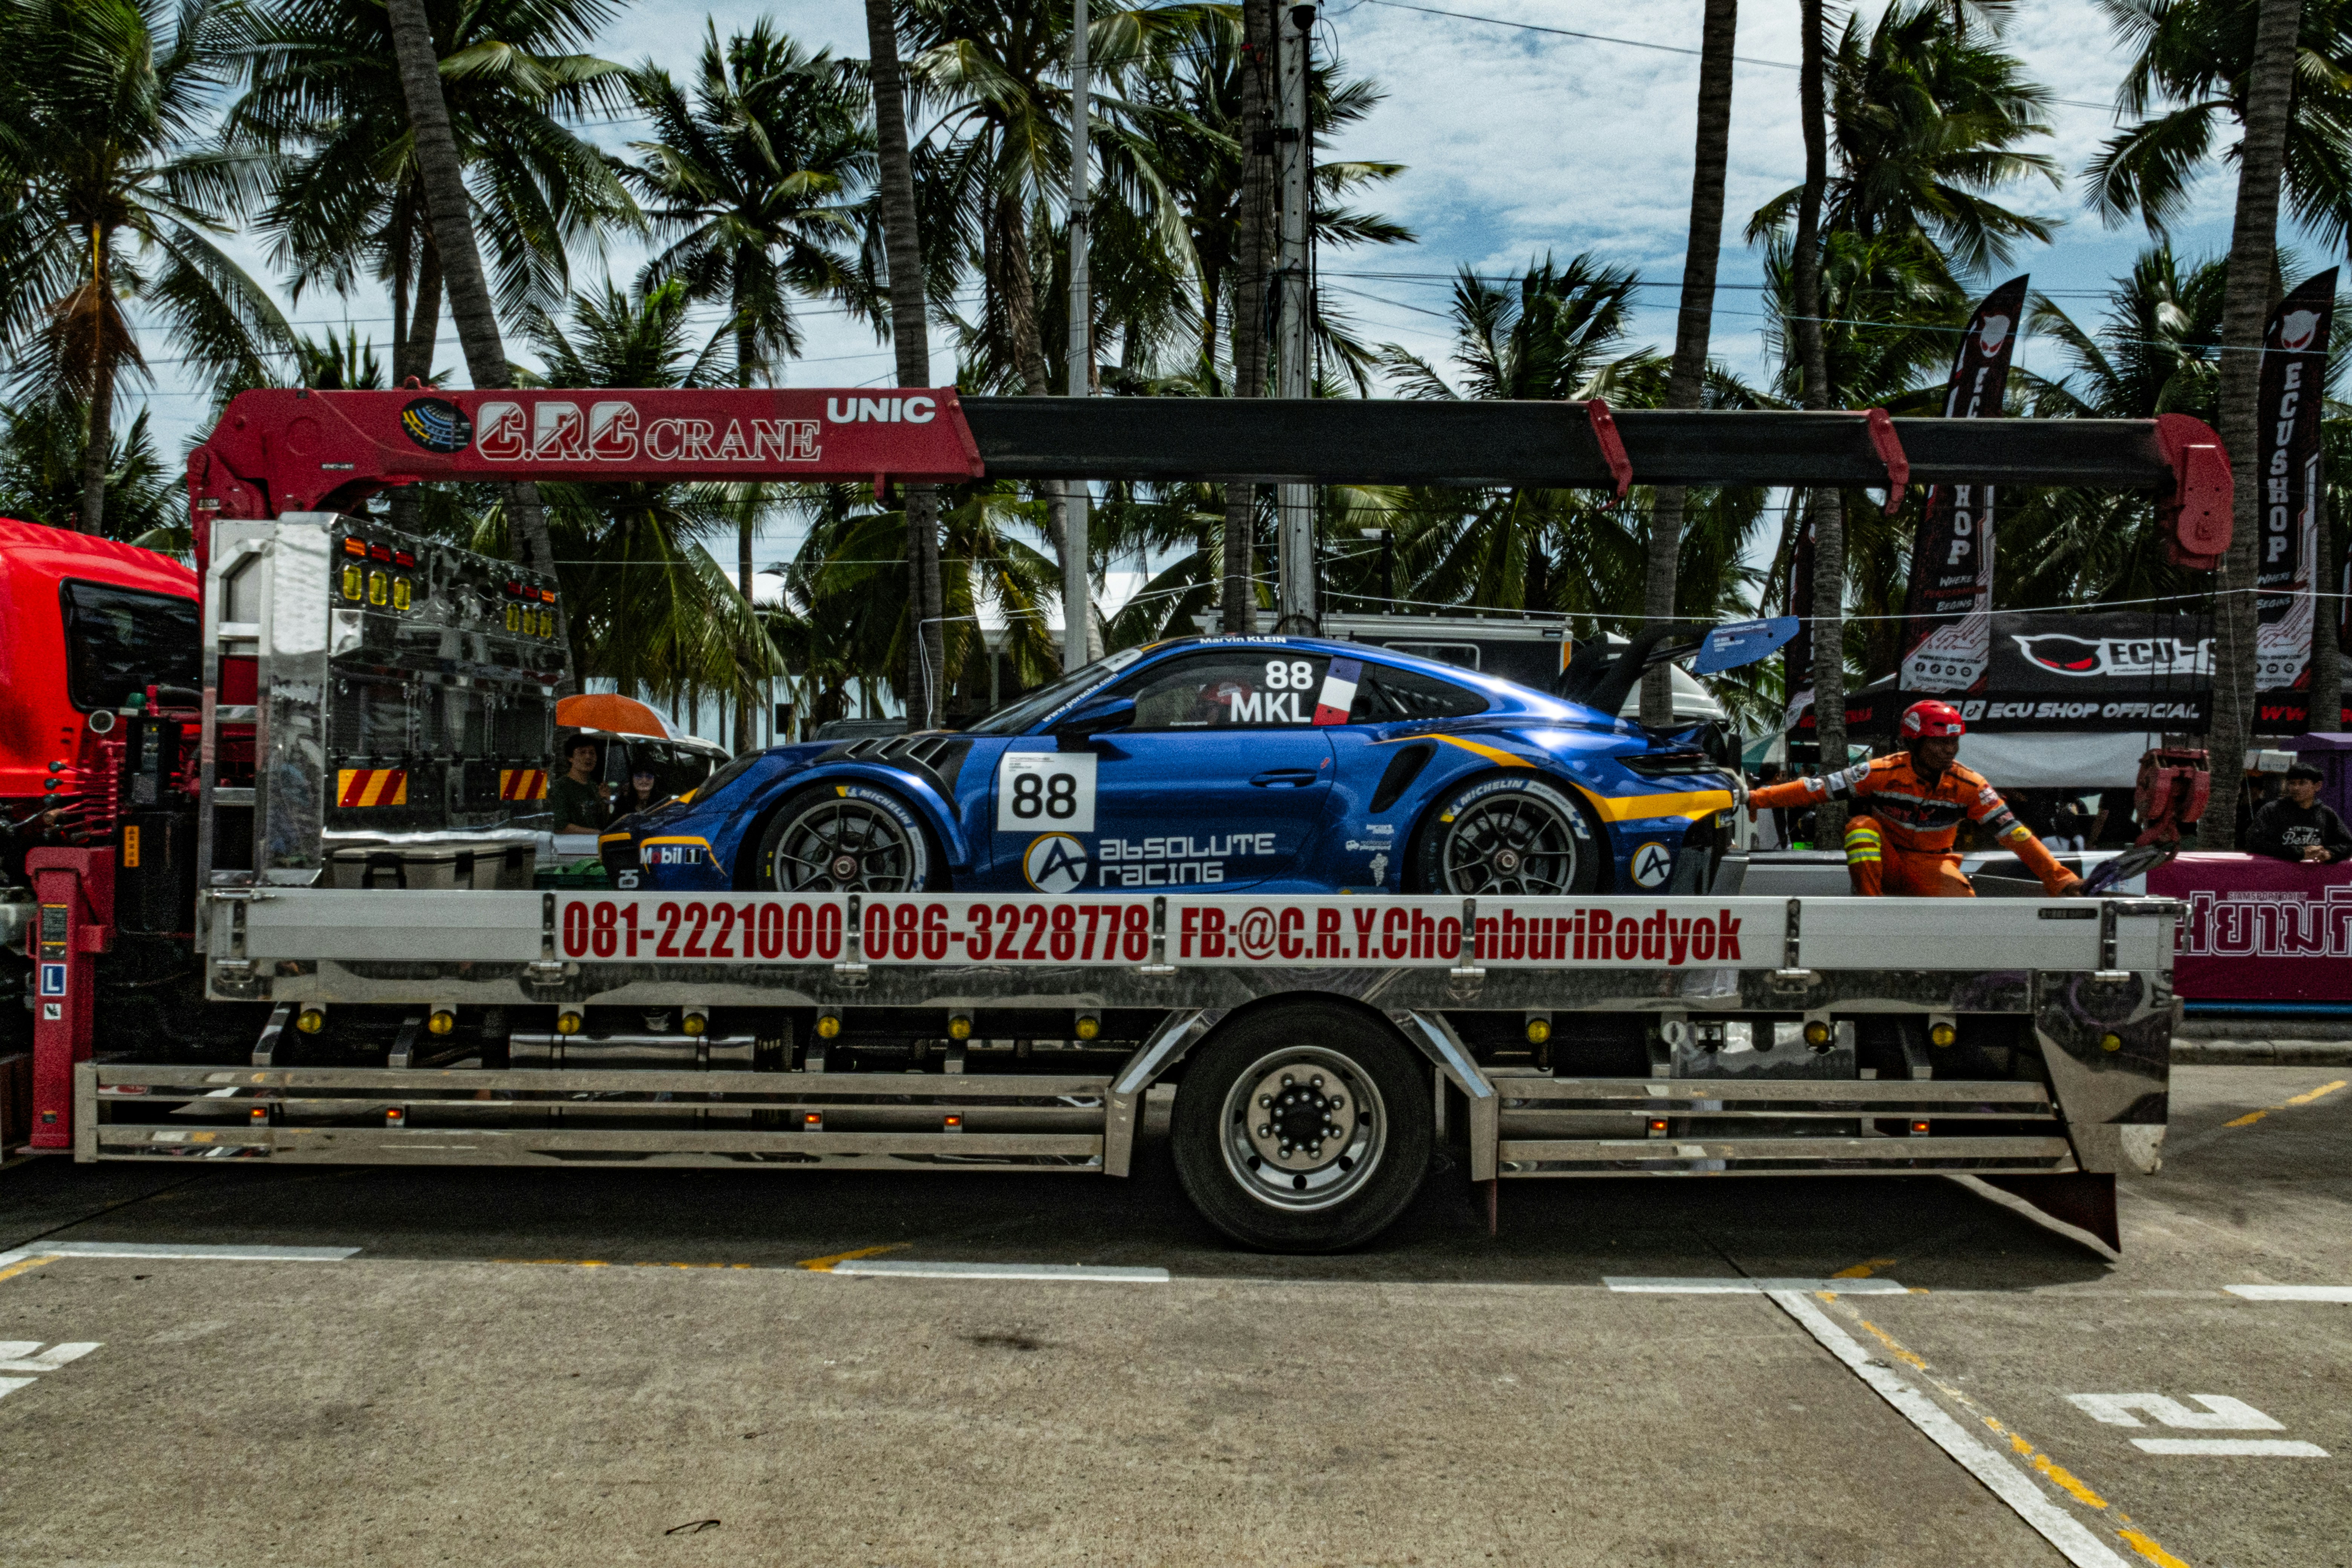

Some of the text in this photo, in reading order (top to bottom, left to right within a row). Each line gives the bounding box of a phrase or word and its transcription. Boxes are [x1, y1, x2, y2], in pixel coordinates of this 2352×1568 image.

[827, 397, 936, 423] UNIC
[645, 418, 821, 462] CRANE
[1265, 661, 1313, 689] 88
[1042, 673, 1119, 722] www.porsche.com
[1230, 692, 1311, 723] MKL
[1987, 701, 2199, 718] ECU SHOP OFFICIAL
[859, 789, 911, 824] MICHELIN
[1012, 773, 1077, 819] 88
[1460, 780, 1524, 805] MICHELIN
[640, 847, 682, 864] Mobil
[563, 901, 842, 959] 081-2221000
[864, 903, 1149, 961] 086-3228778
[47, 968, 60, 991] L
